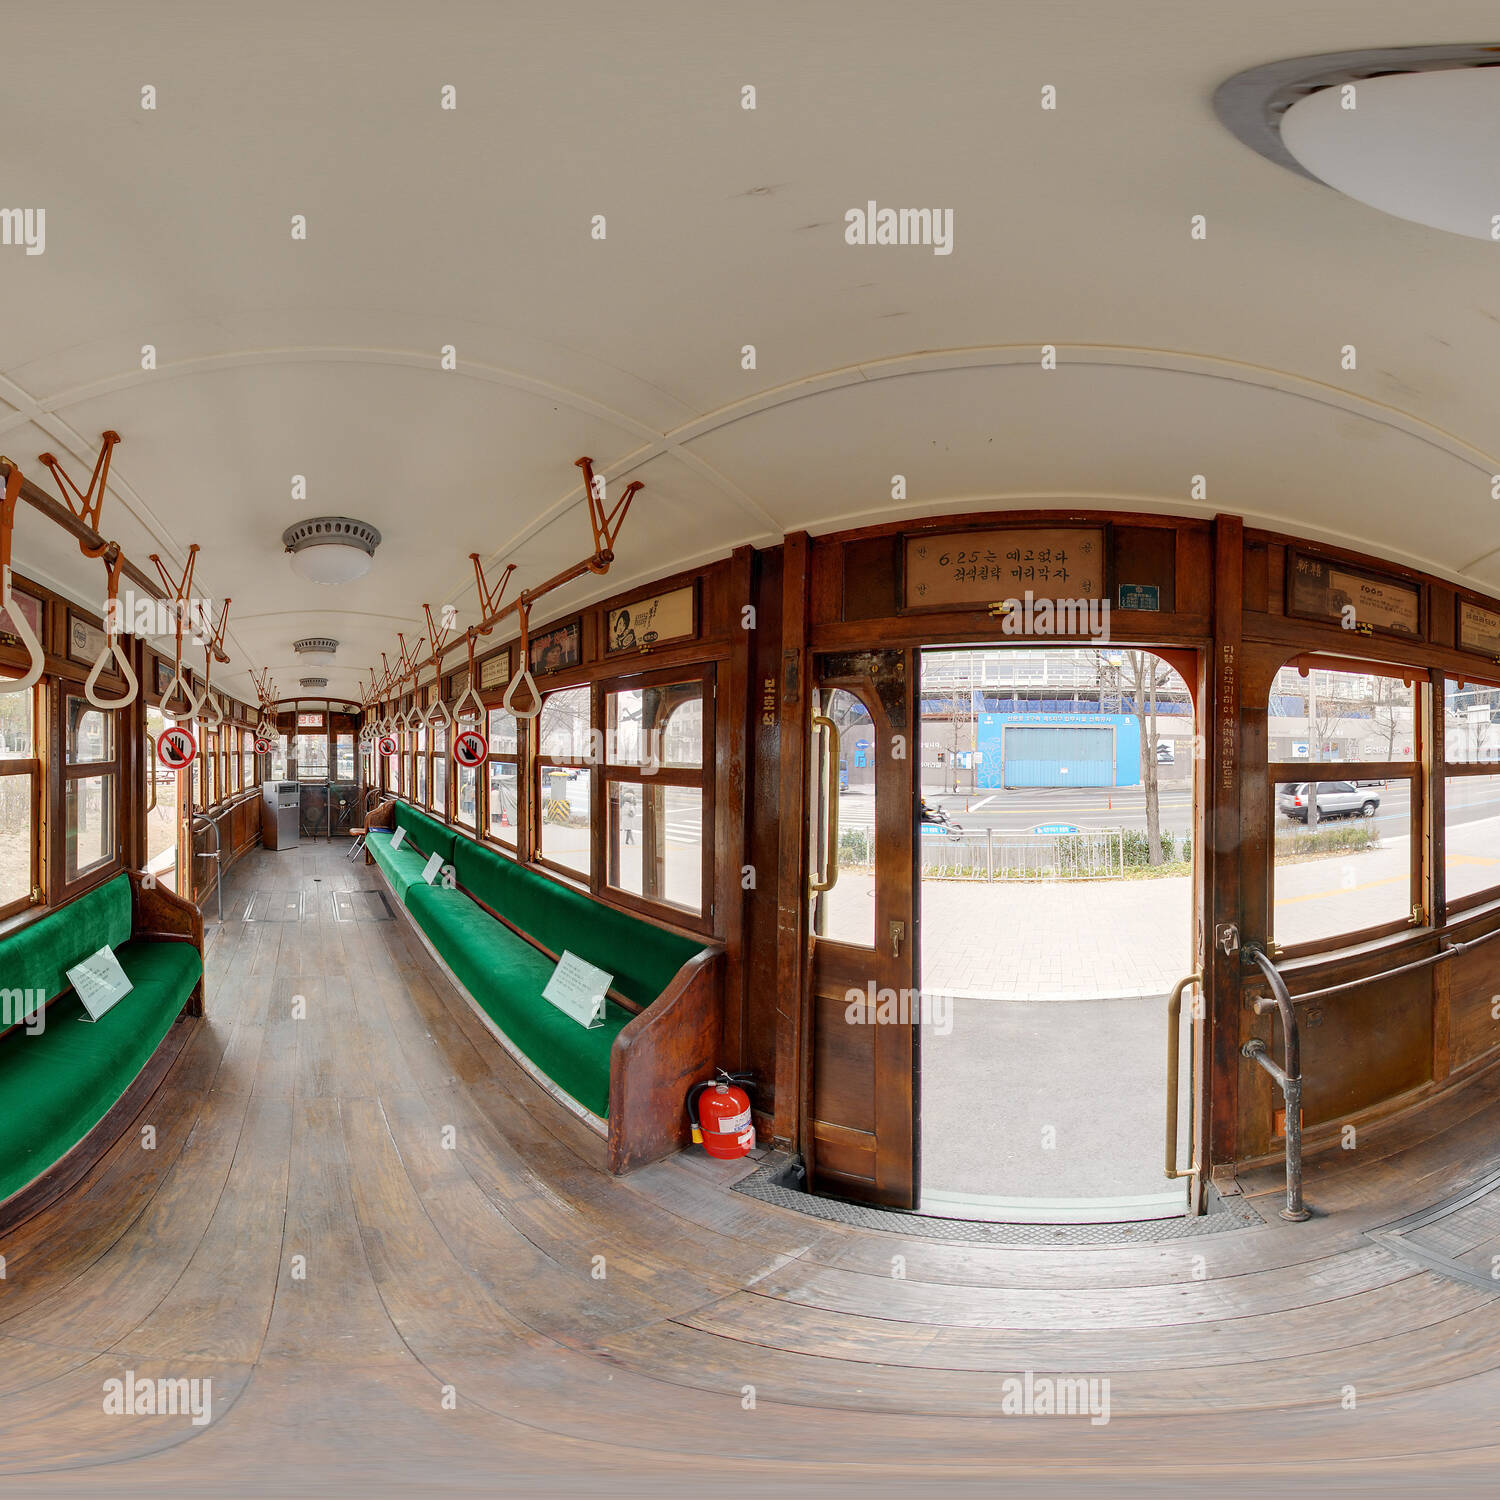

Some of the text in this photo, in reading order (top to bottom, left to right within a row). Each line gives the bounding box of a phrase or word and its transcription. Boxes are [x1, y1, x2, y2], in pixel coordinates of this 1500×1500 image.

[938, 549, 1069, 567] 6.25는 예고없다
[763, 678, 776, 727] 보호석
